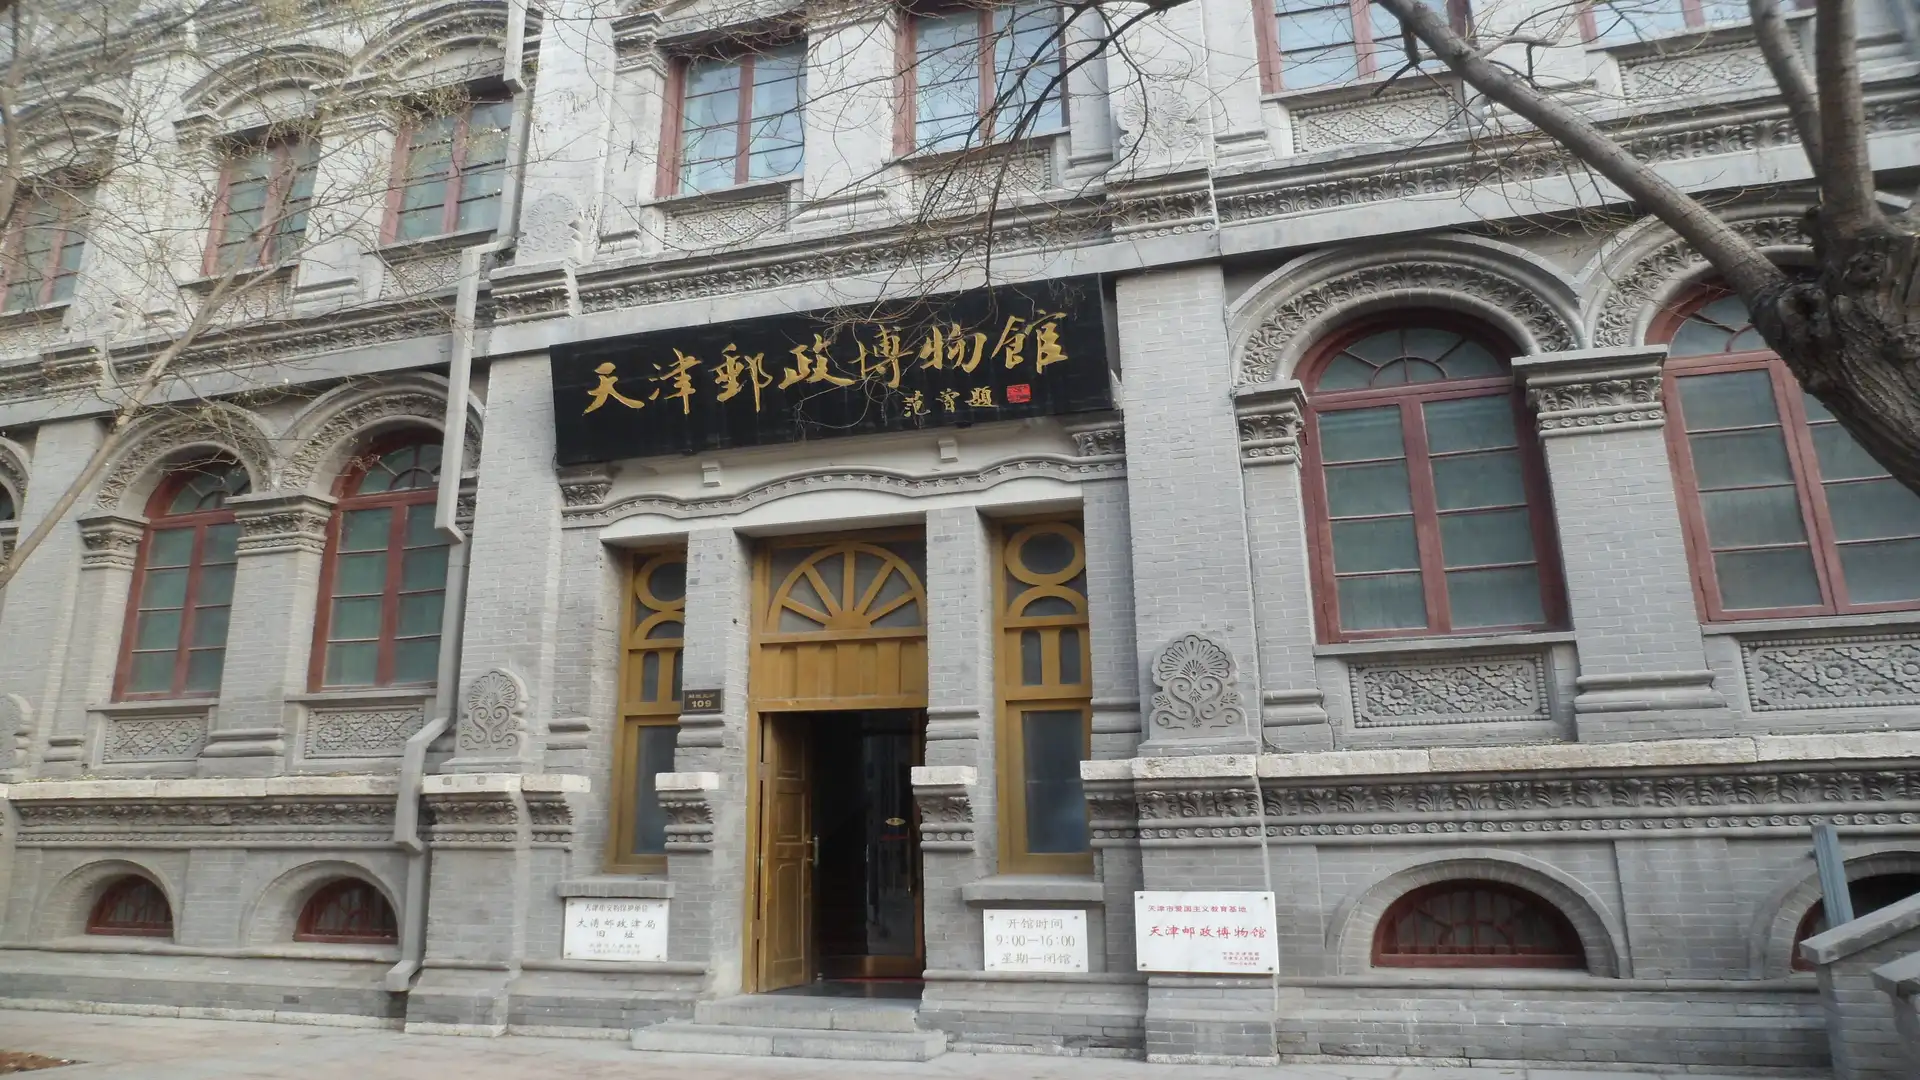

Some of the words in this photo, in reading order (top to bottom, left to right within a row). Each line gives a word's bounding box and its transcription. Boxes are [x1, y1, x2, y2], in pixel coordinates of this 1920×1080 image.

[691, 700, 712, 708] 109
[1148, 905, 1248, 913] 天津市爱国主义教育基地
[576, 917, 656, 930] 大清邮政津局
[1007, 918, 1063, 929] 开馆时间
[1148, 924, 1267, 939] 天津邮政博物馆
[1001, 952, 1072, 965] 星期一闭馆
